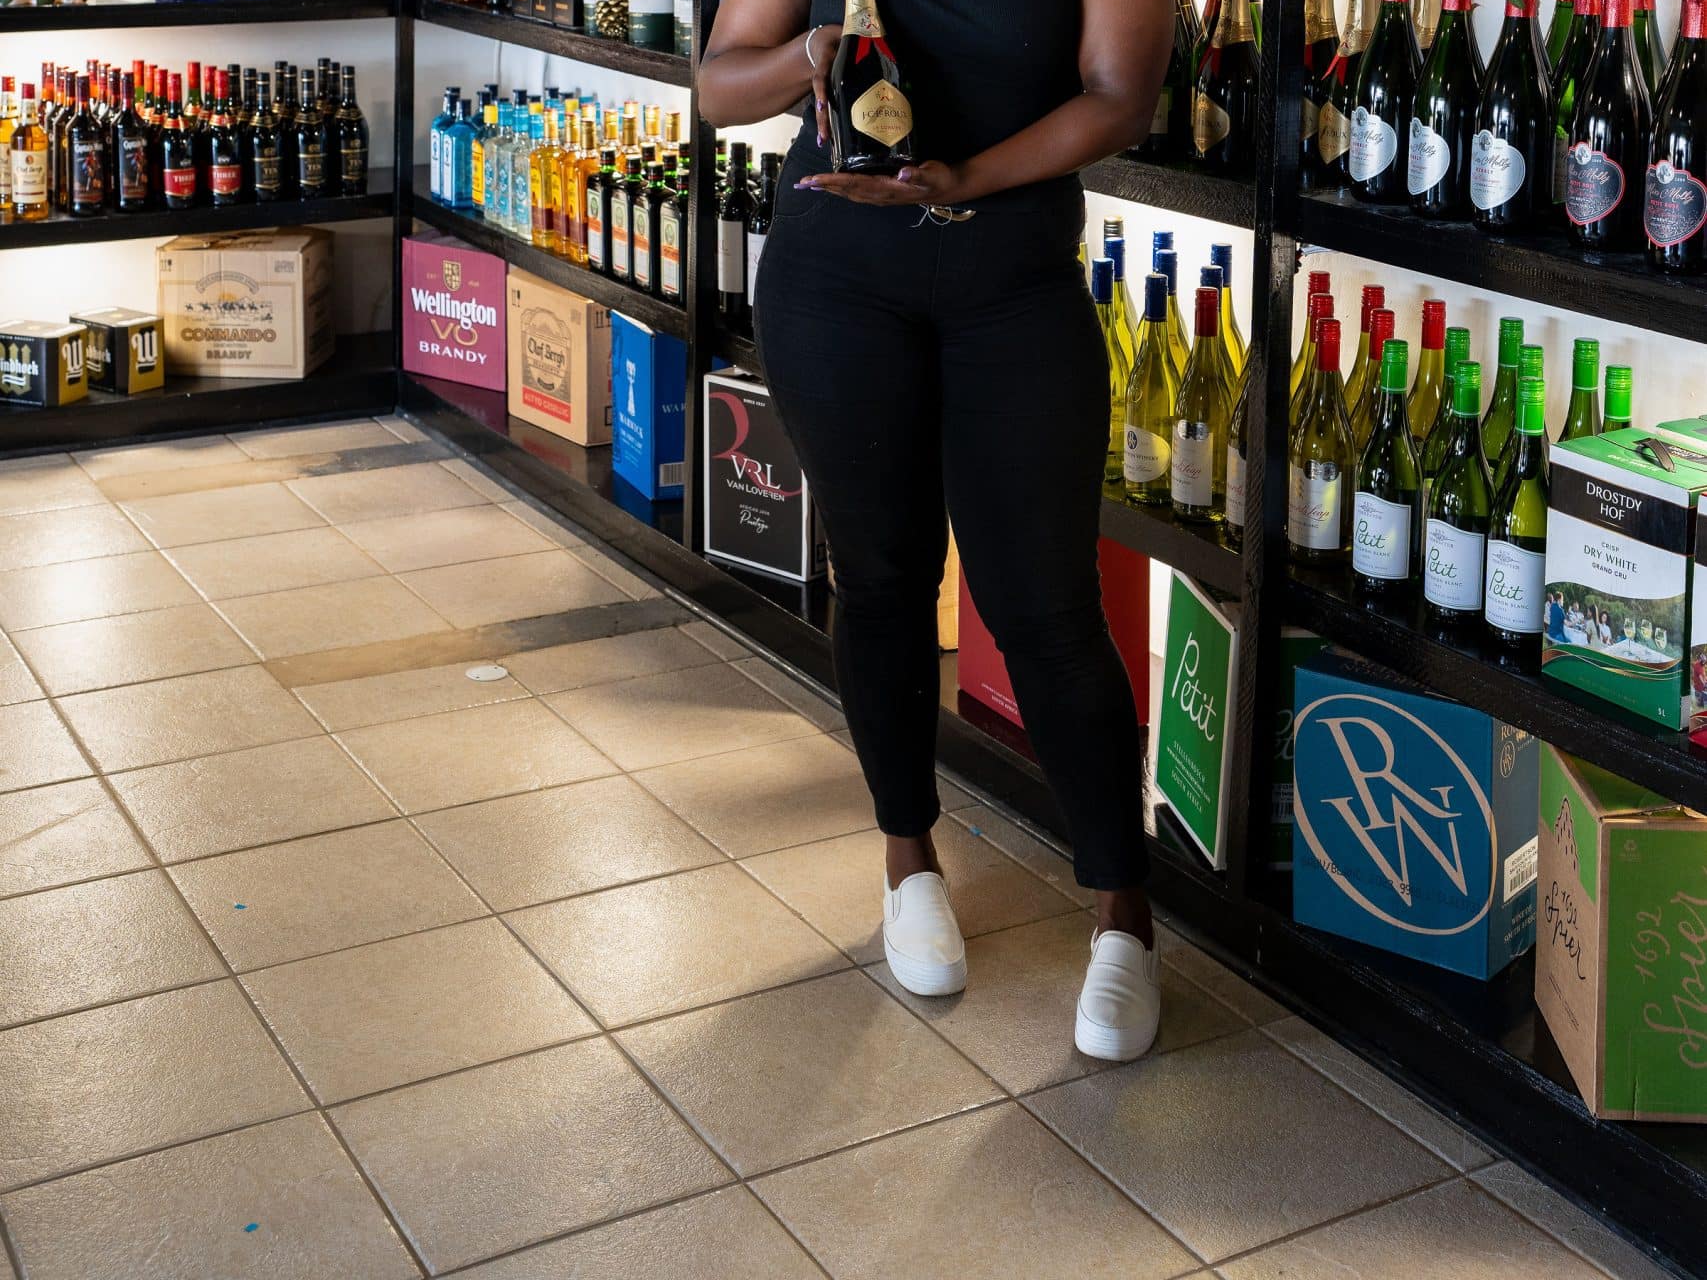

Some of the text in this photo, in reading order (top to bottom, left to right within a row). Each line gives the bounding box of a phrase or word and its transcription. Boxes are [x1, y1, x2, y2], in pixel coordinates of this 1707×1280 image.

[1659, 186, 1696, 205] Molly
[411, 287, 497, 330] Wellington
[180, 327, 277, 343] COMMANDO
[430, 319, 478, 346] VO
[206, 349, 253, 360] BRANDY
[418, 340, 488, 365] BRANDY
[0, 358, 39, 376] indhoek
[726, 478, 786, 503] VAN LOVEREN
[1586, 481, 1642, 512] DROSTDY
[1600, 503, 1626, 521] HOF
[1354, 518, 1387, 549] Petit
[1601, 541, 1620, 552] CRISP
[1426, 546, 1458, 579] Petit
[1583, 544, 1638, 574] DRY WHITE
[1591, 561, 1628, 580] GRAND CRU
[1489, 568, 1524, 601] Petit
[1171, 631, 1217, 742] Petit
[1631, 906, 1671, 985] 1692
